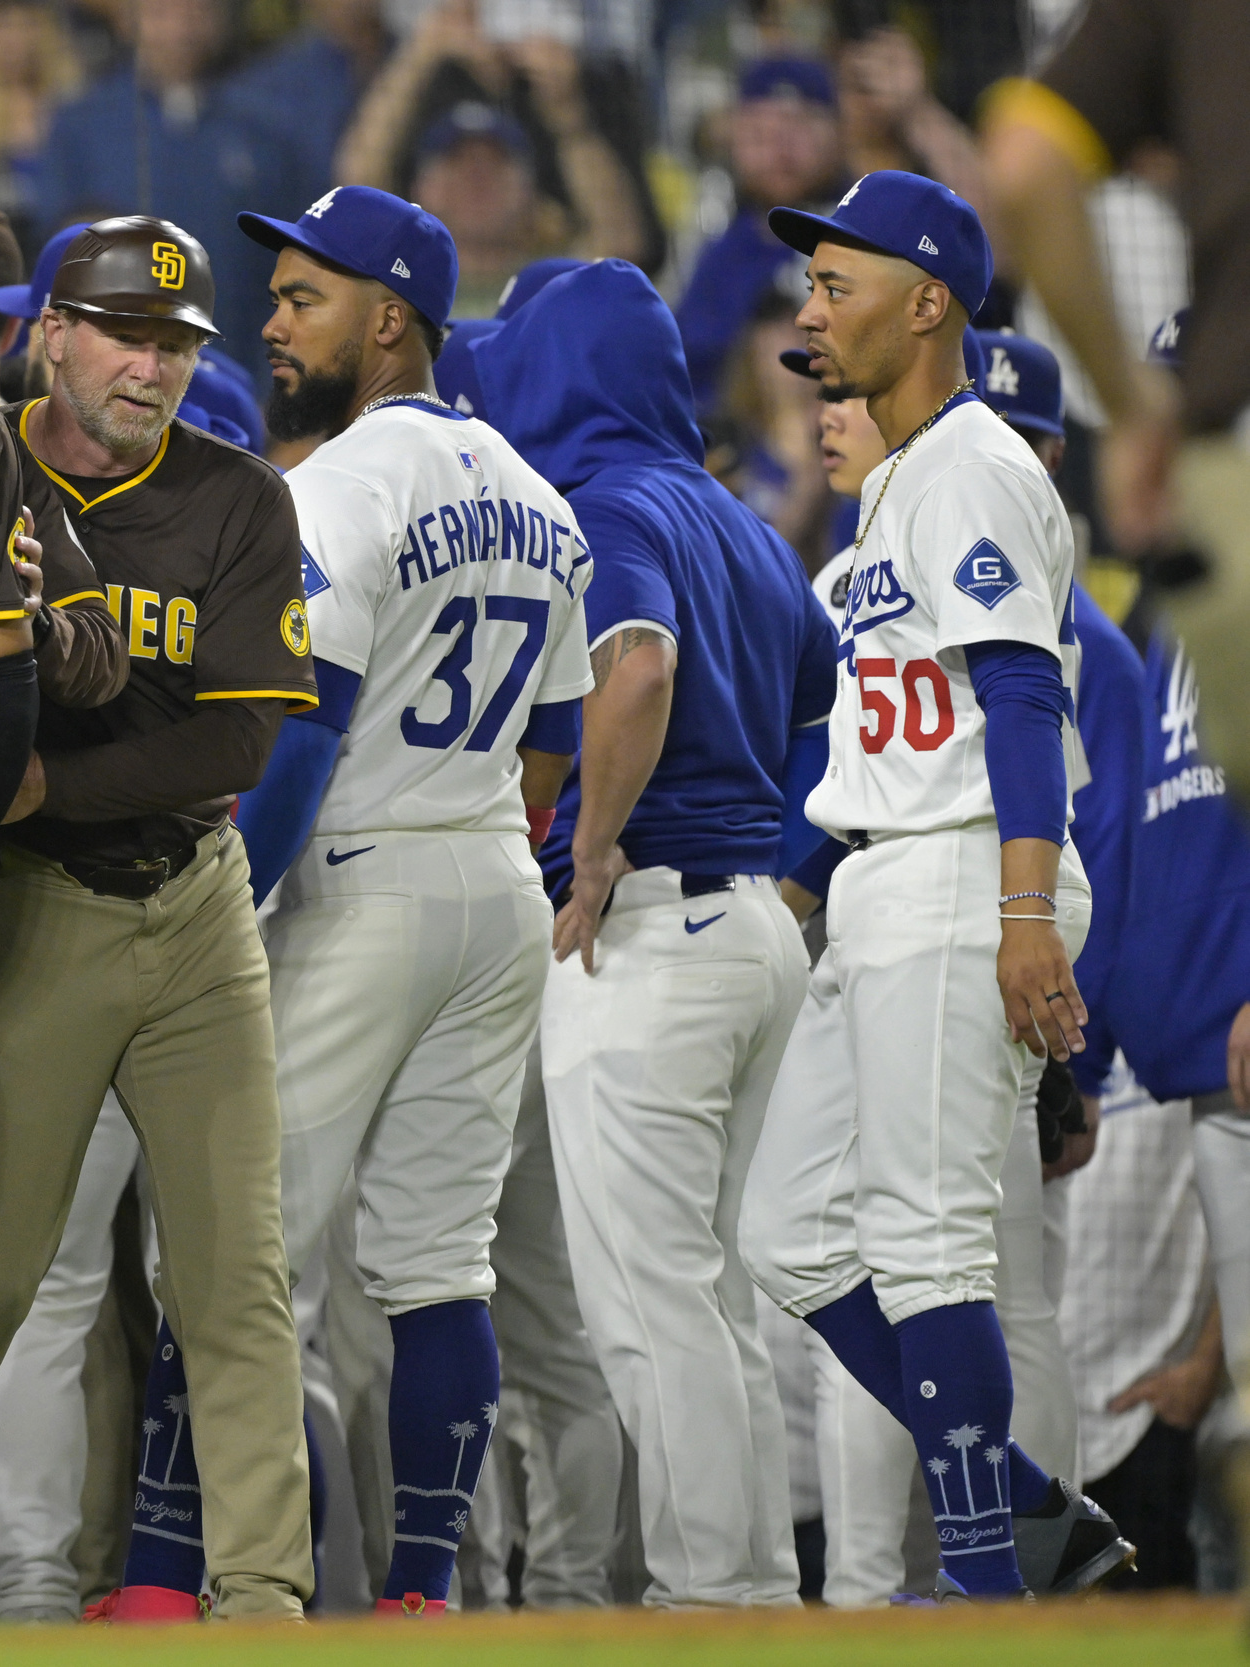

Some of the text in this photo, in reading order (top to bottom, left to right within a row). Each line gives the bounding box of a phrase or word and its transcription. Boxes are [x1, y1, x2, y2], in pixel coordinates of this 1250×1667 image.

[151, 241, 186, 291] SD
[966, 581, 1010, 590] GUGGENHEIM
[400, 595, 551, 753] 37
[855, 657, 955, 755] 50
[134, 1491, 194, 1523] Dodgers
[938, 1525, 1004, 1546] Dodgers
